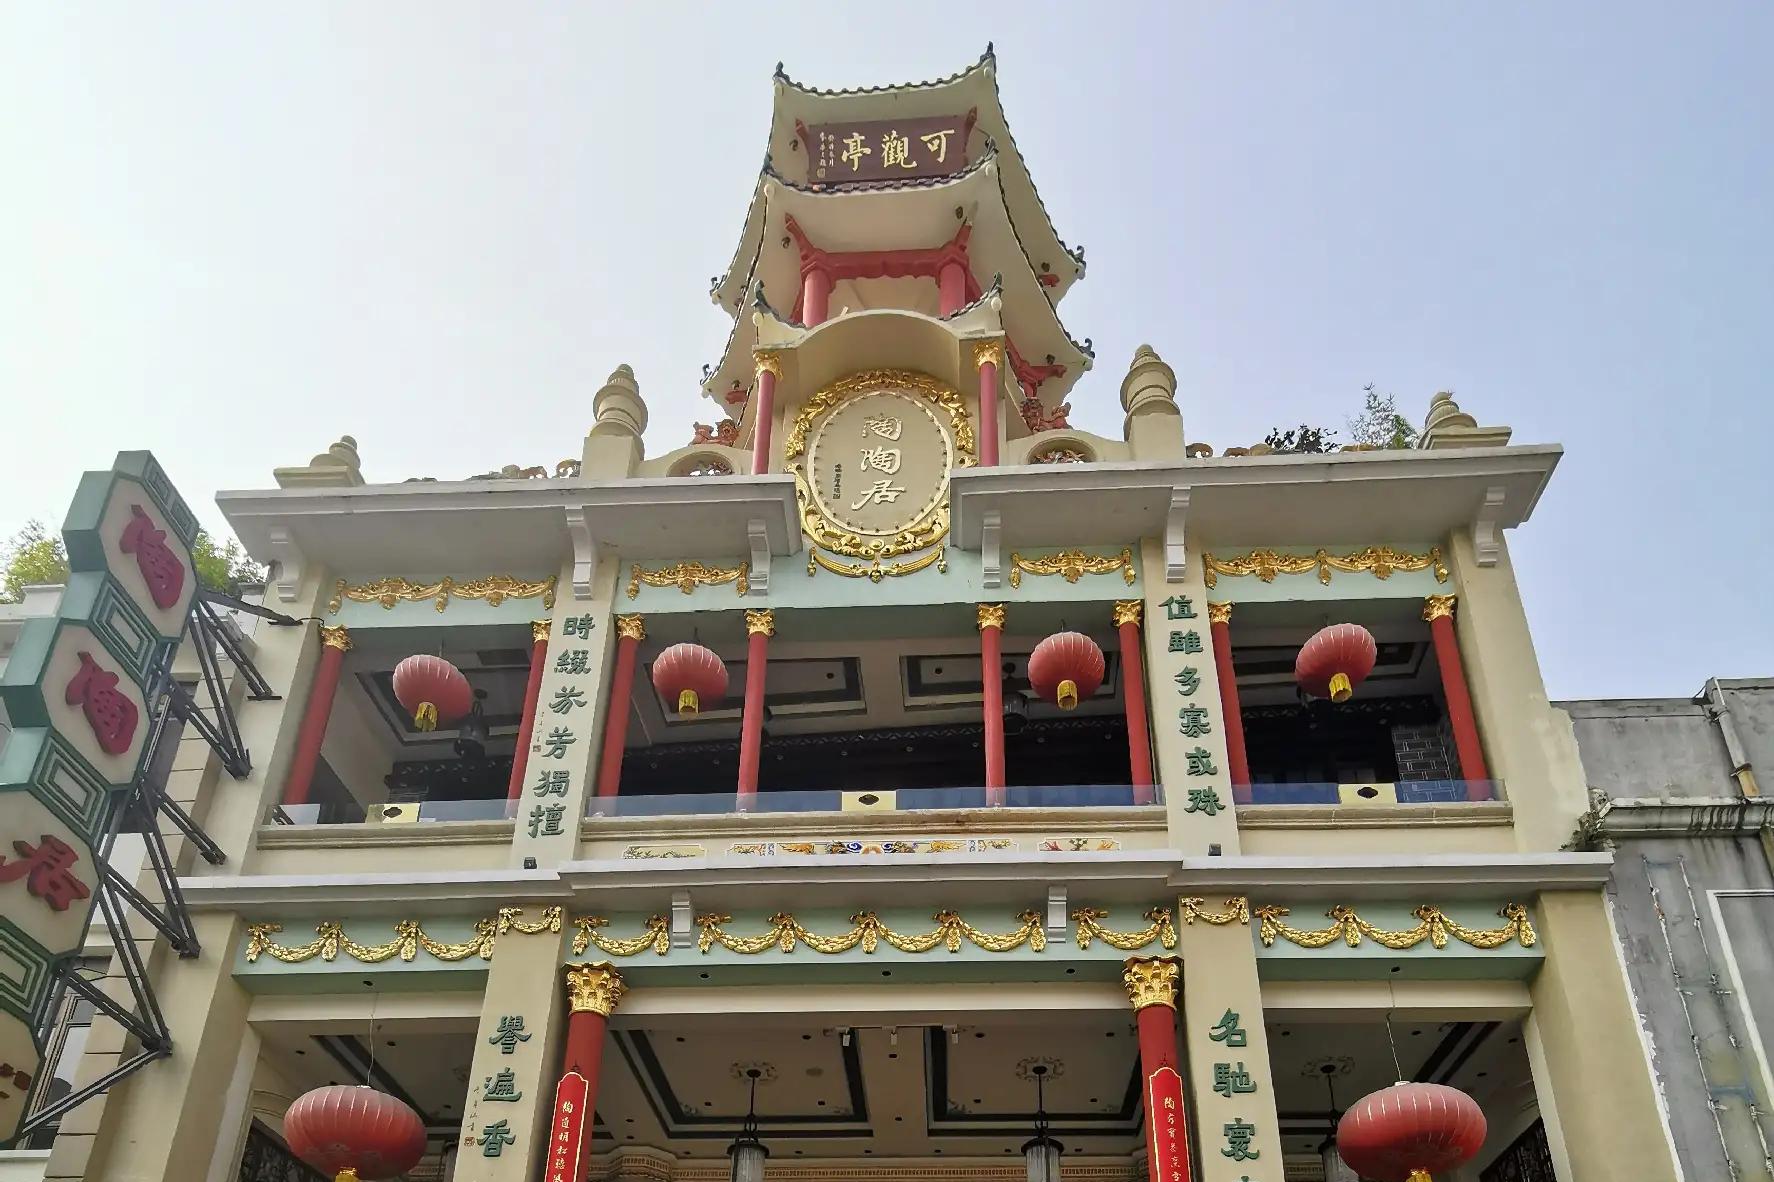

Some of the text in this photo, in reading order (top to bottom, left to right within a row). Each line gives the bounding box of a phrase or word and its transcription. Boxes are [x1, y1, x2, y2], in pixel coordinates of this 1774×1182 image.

[841, 128, 955, 172] 可觀亭
[851, 414, 905, 511] 陶陶居
[0, 504, 185, 1098] 陶陶居
